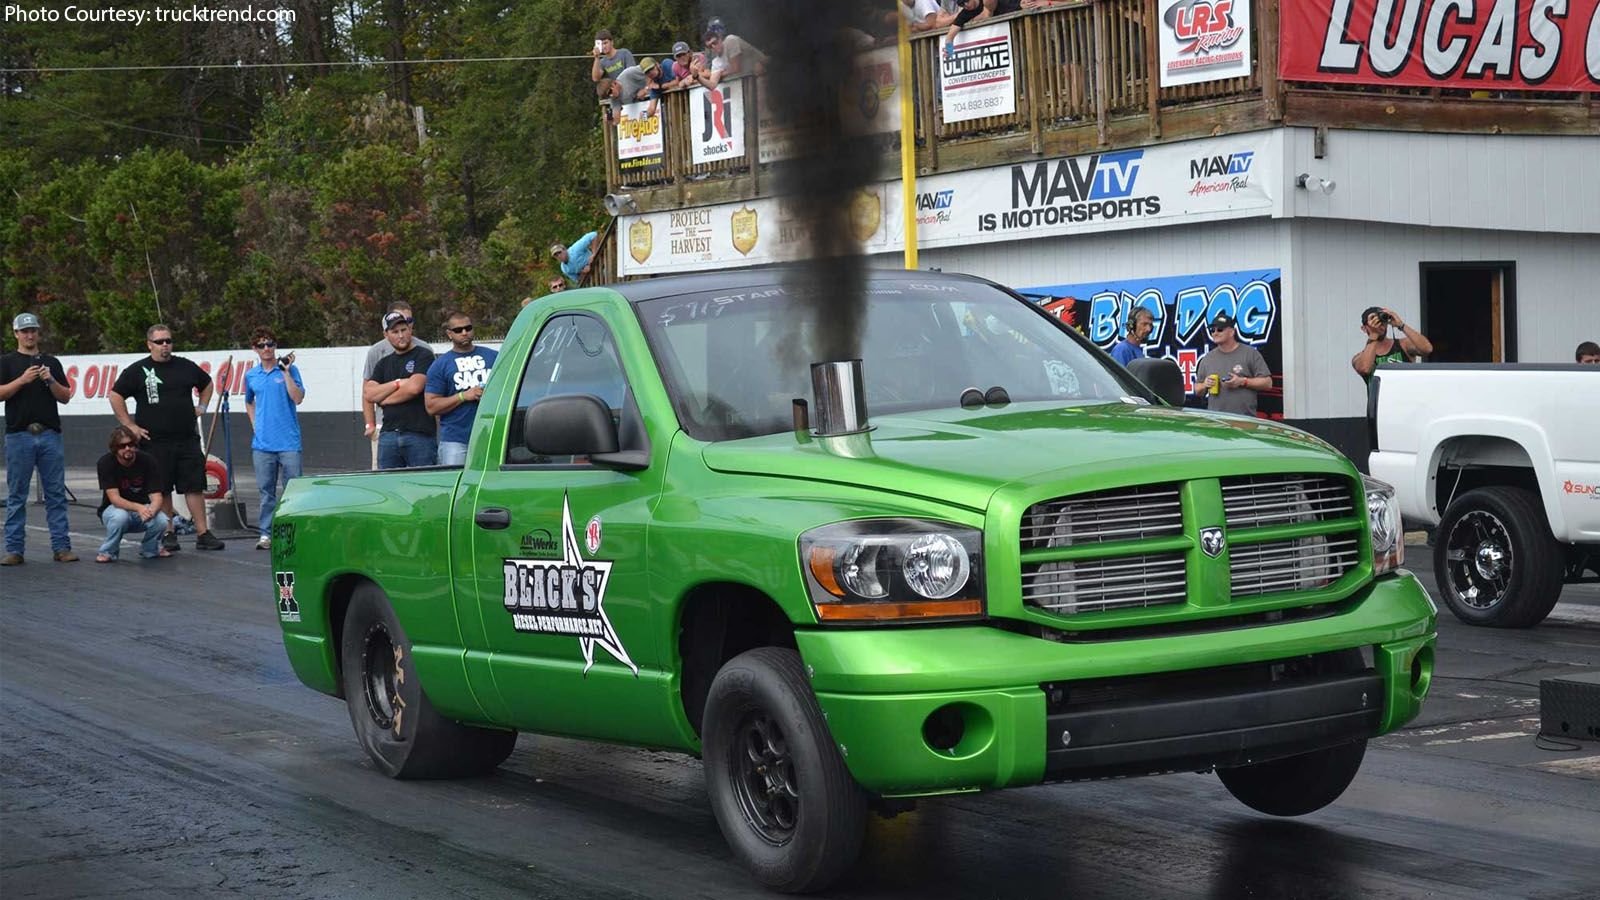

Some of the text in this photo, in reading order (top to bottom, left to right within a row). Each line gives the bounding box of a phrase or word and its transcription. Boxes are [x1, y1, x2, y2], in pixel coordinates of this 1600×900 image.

[1175, 1, 1232, 39] LRS
[1195, 26, 1245, 54] Racing
[1319, 0, 1568, 84] LUCAS
[944, 43, 1010, 77] ULTIMATE
[978, 69, 1006, 80] CONCEPTS
[703, 143, 728, 156] shocks
[1011, 149, 1144, 209] MAVTV
[1190, 151, 1254, 179] MAVTV
[1188, 175, 1249, 197] American Real
[670, 209, 713, 228] PROTECT
[978, 195, 1161, 232] IS MOTORSPORTS
[671, 237, 712, 255] HARVEST
[685, 228, 697, 238] THE
[1089, 280, 1276, 350] BIG DOG
[454, 355, 486, 371] BIG
[503, 564, 596, 611] BLACK'S
[513, 613, 538, 631] DIESEL
